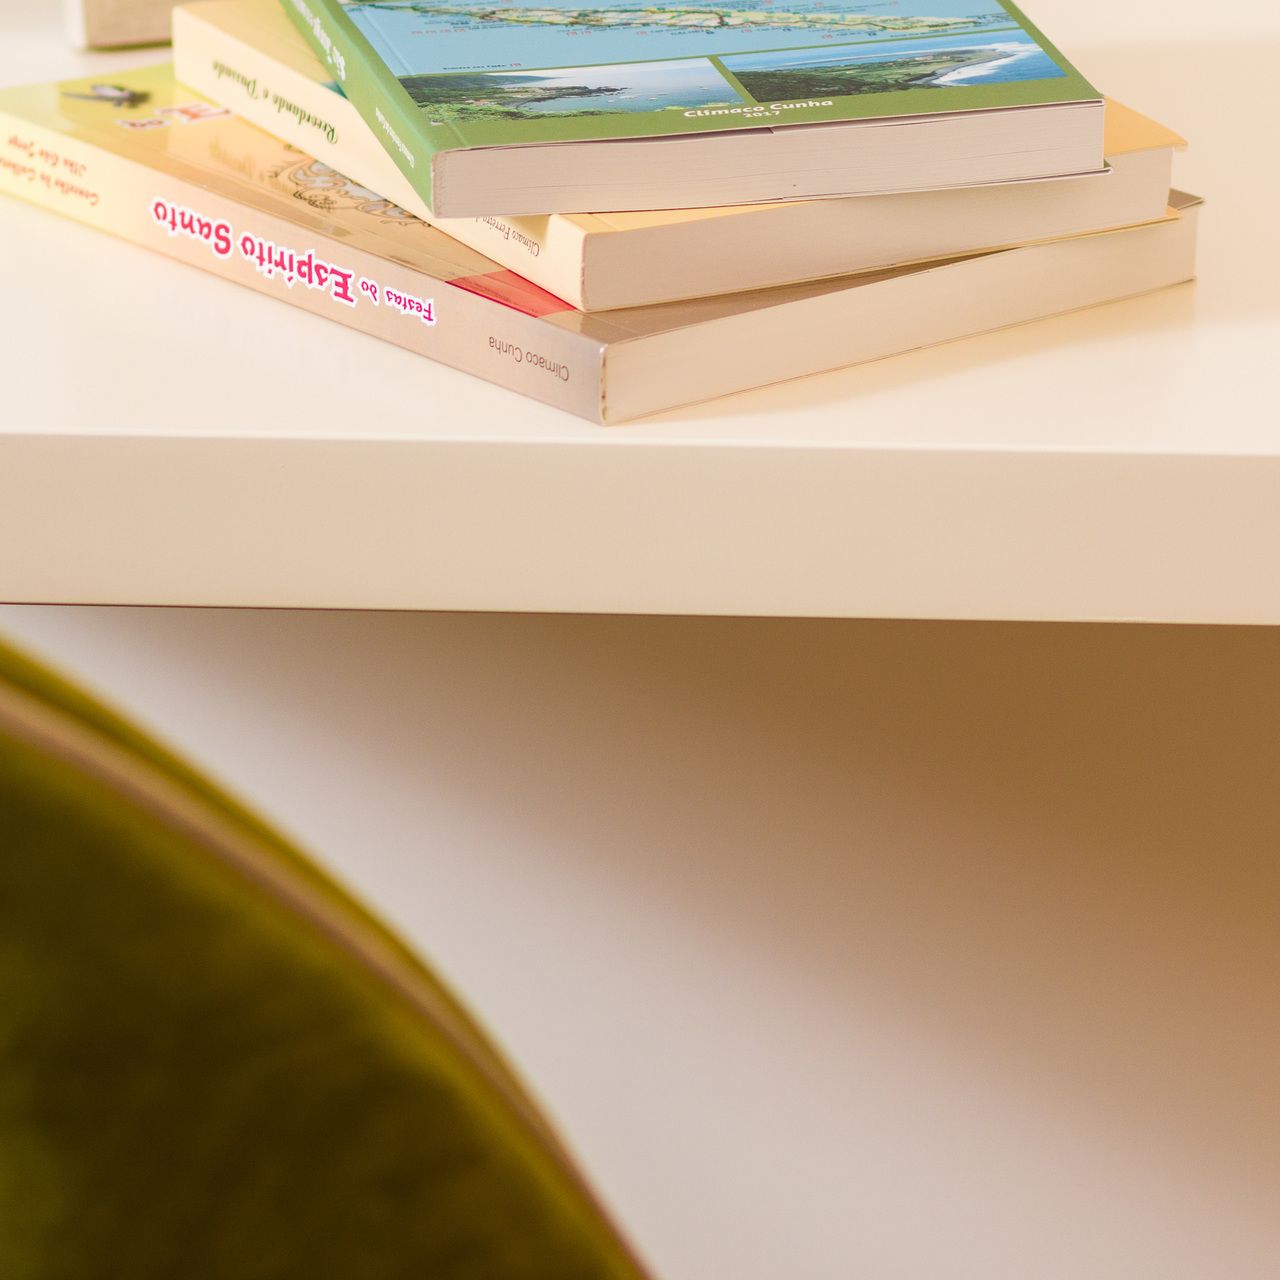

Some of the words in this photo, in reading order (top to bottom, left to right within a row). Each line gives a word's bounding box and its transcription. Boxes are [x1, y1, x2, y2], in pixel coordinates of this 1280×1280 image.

[743, 110, 781, 118] 2017
[770, 99, 834, 111] Cunha
[153, 201, 231, 255] Santo
[240, 235, 355, 303] Espírito
[360, 280, 378, 302] do
[385, 289, 434, 322] Festas
[488, 336, 523, 363] Cunha
